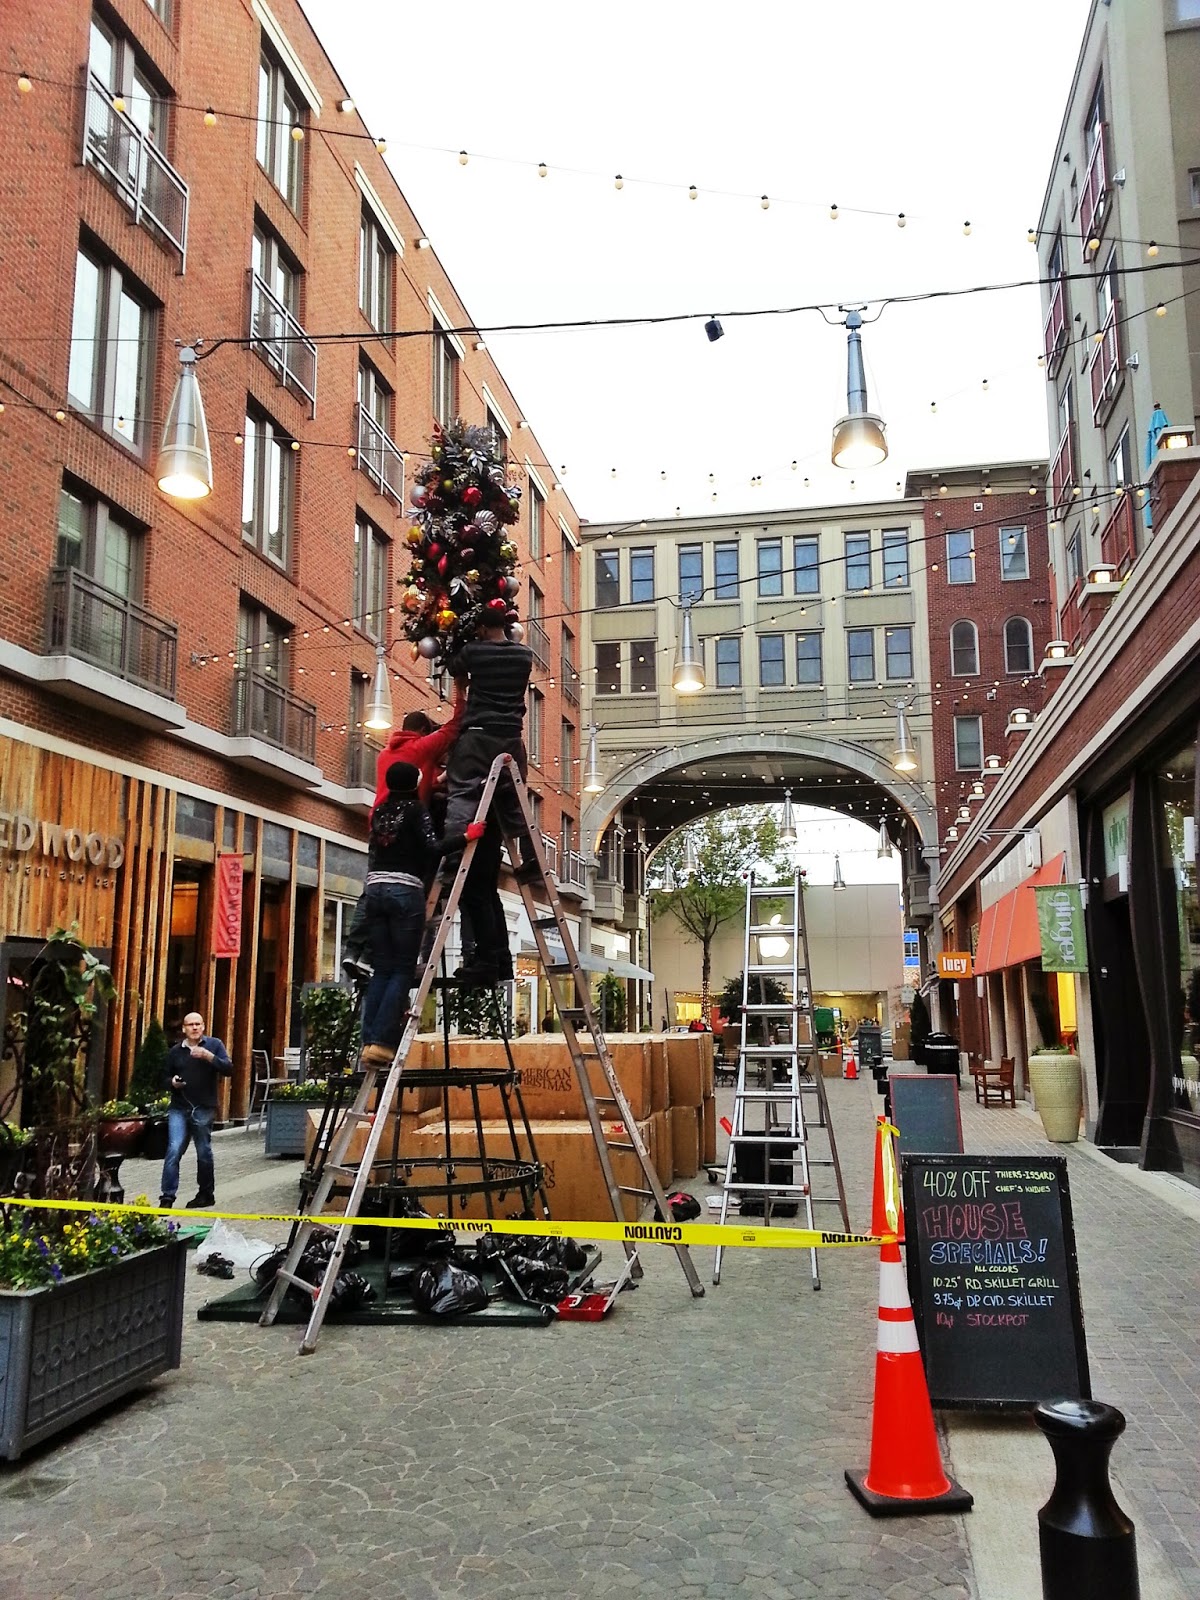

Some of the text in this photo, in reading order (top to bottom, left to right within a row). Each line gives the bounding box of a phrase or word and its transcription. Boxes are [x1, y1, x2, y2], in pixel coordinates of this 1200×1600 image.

[227, 862, 240, 947] REDWOOD
[1045, 891, 1076, 964] ginger
[942, 956, 967, 973] lucy
[521, 1066, 571, 1080] MERICAN
[521, 1079, 572, 1092] HRISTMAS
[923, 1170, 1056, 1198] 40% OFF THIERS-ISSARD
[995, 1184, 1023, 1193] CHEF'S
[922, 1201, 1028, 1240] HOUSE
[624, 1225, 682, 1240] CAUTION
[929, 1238, 1048, 1265] SPECIALS!
[974, 1265, 1019, 1273] ALL COLORS
[984, 1276, 1026, 1288] SKILLET
[1028, 1276, 1060, 1288] GRILL
[1008, 1292, 1055, 1306] SKILLET
[966, 1313, 1030, 1327] STOCKPOT
